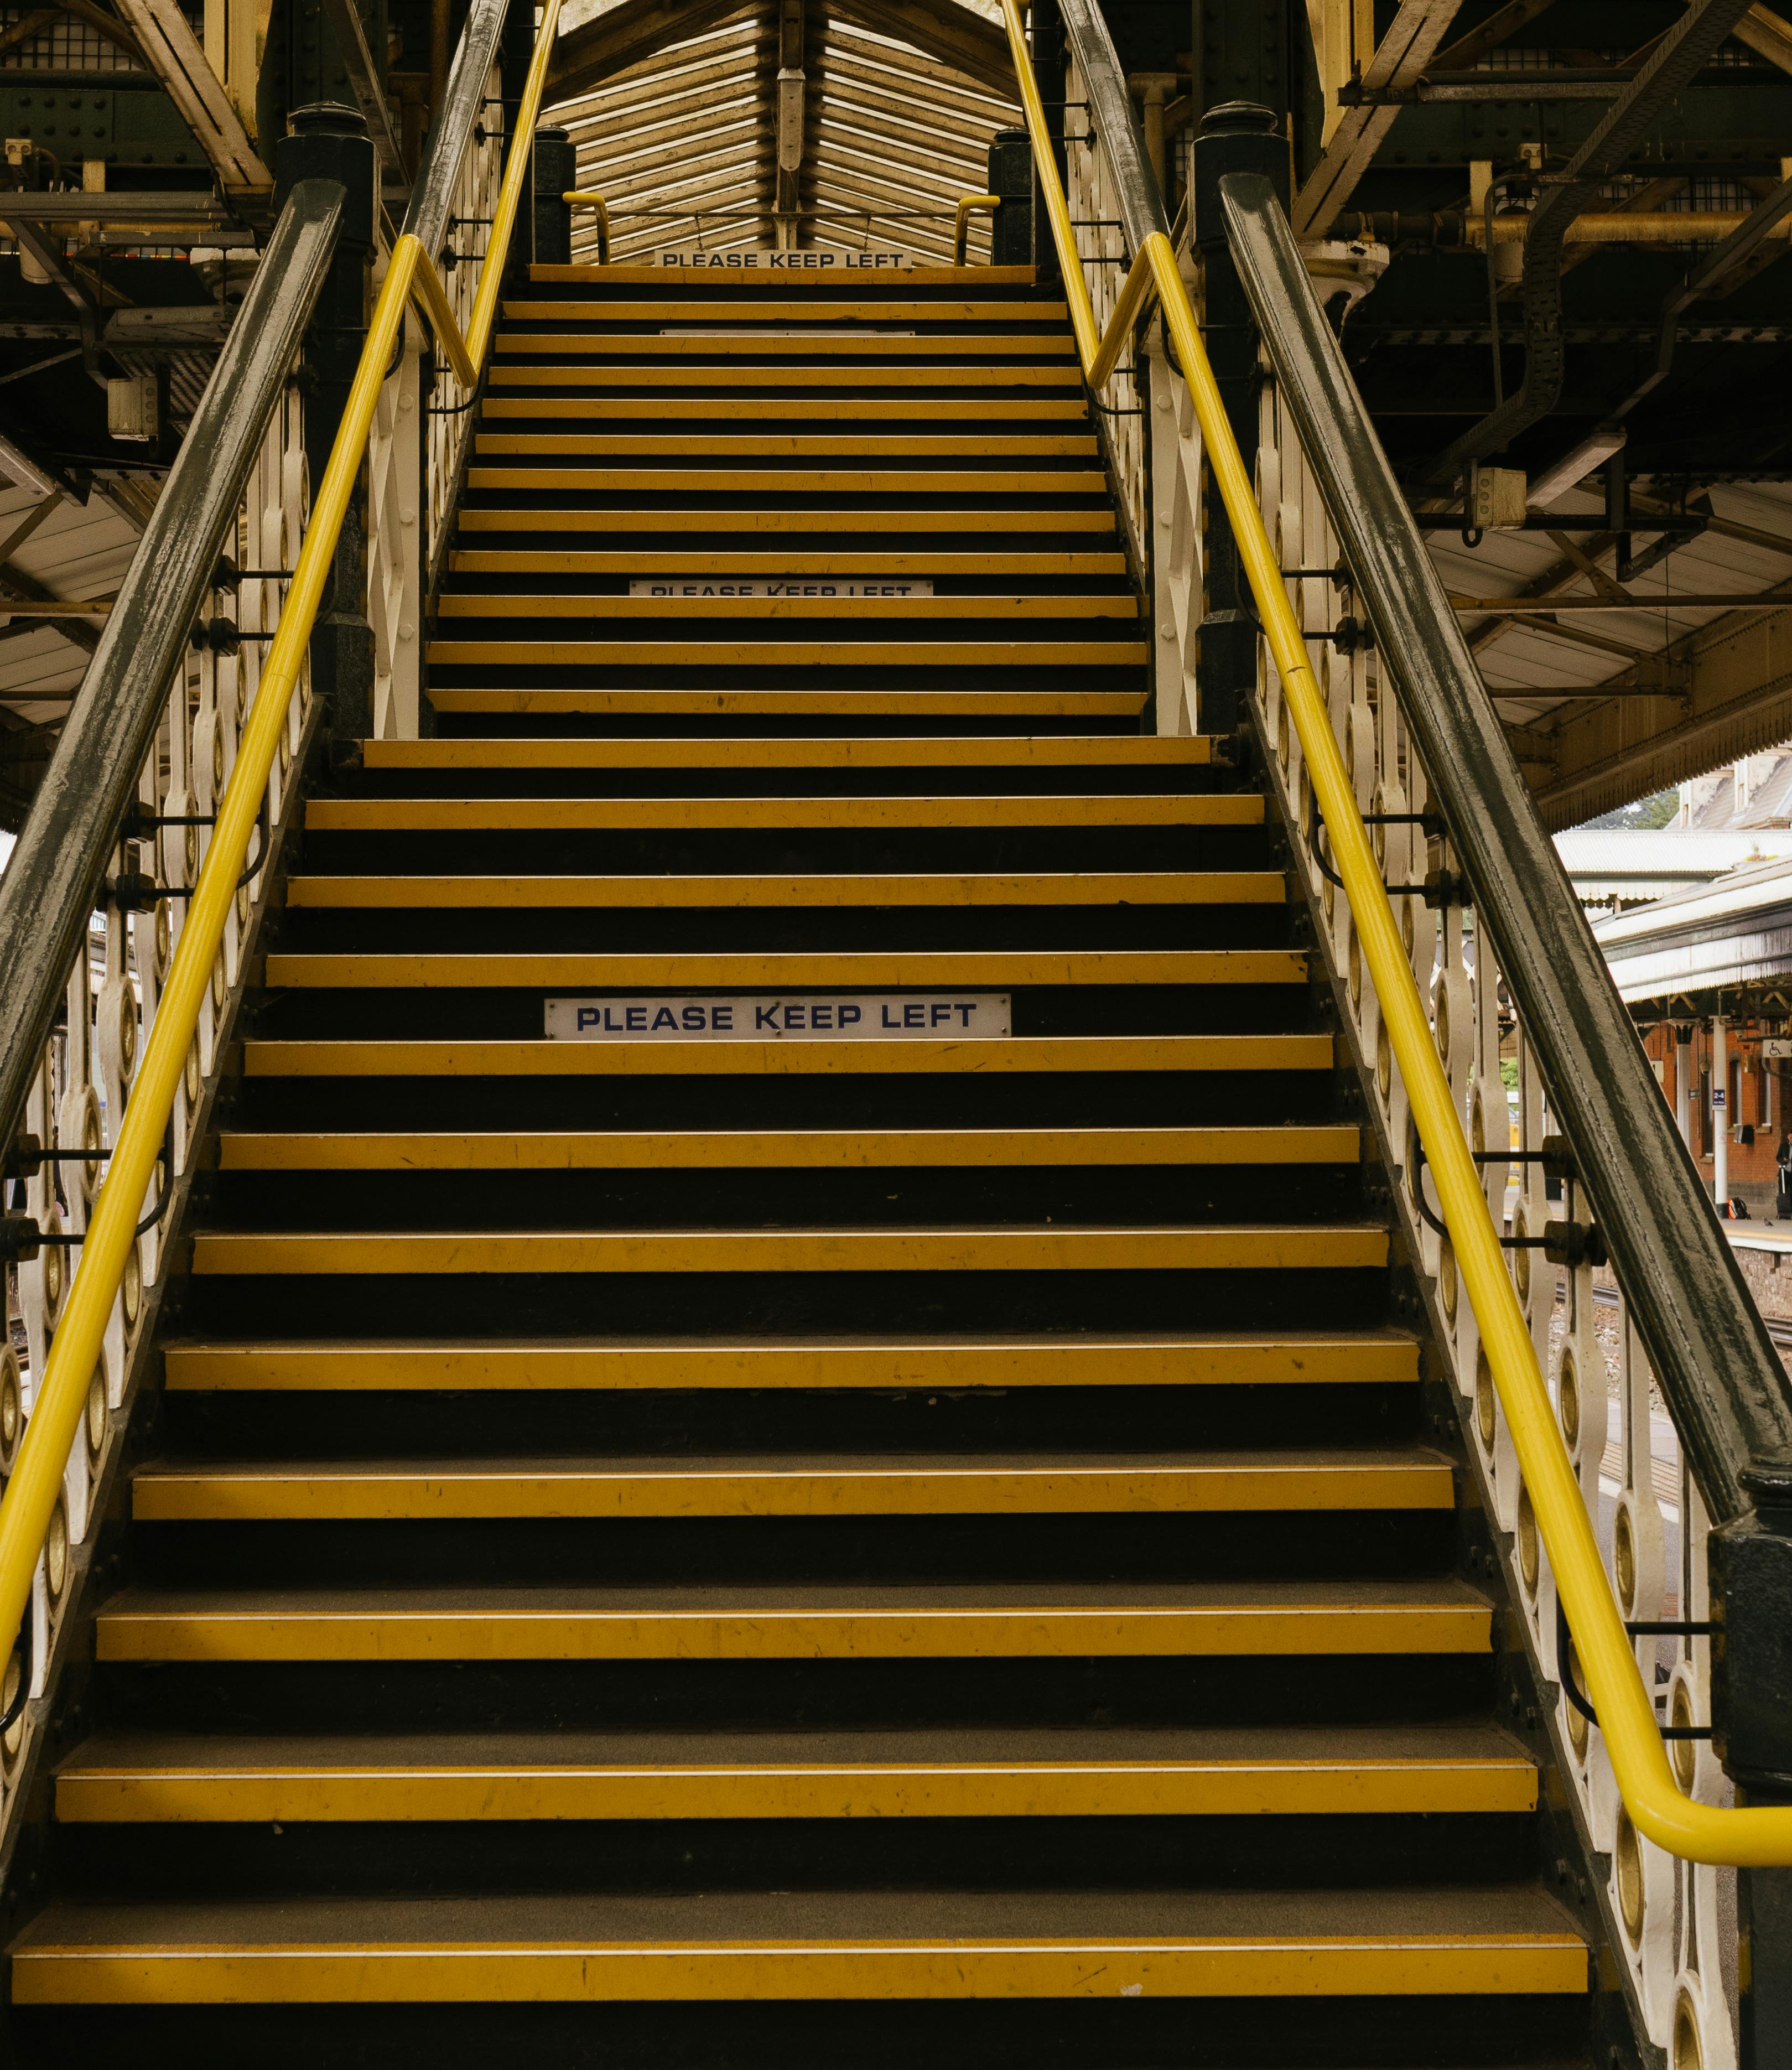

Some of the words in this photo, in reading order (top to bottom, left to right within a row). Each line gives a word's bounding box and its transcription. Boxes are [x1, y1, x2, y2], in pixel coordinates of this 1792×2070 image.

[663, 253, 758, 268] PLEASE
[770, 253, 834, 268] KEEP
[846, 253, 903, 268] LEFT
[577, 1006, 733, 1031] PLEASE
[755, 1005, 861, 1030] KEEP
[882, 1003, 977, 1028] LEFT
